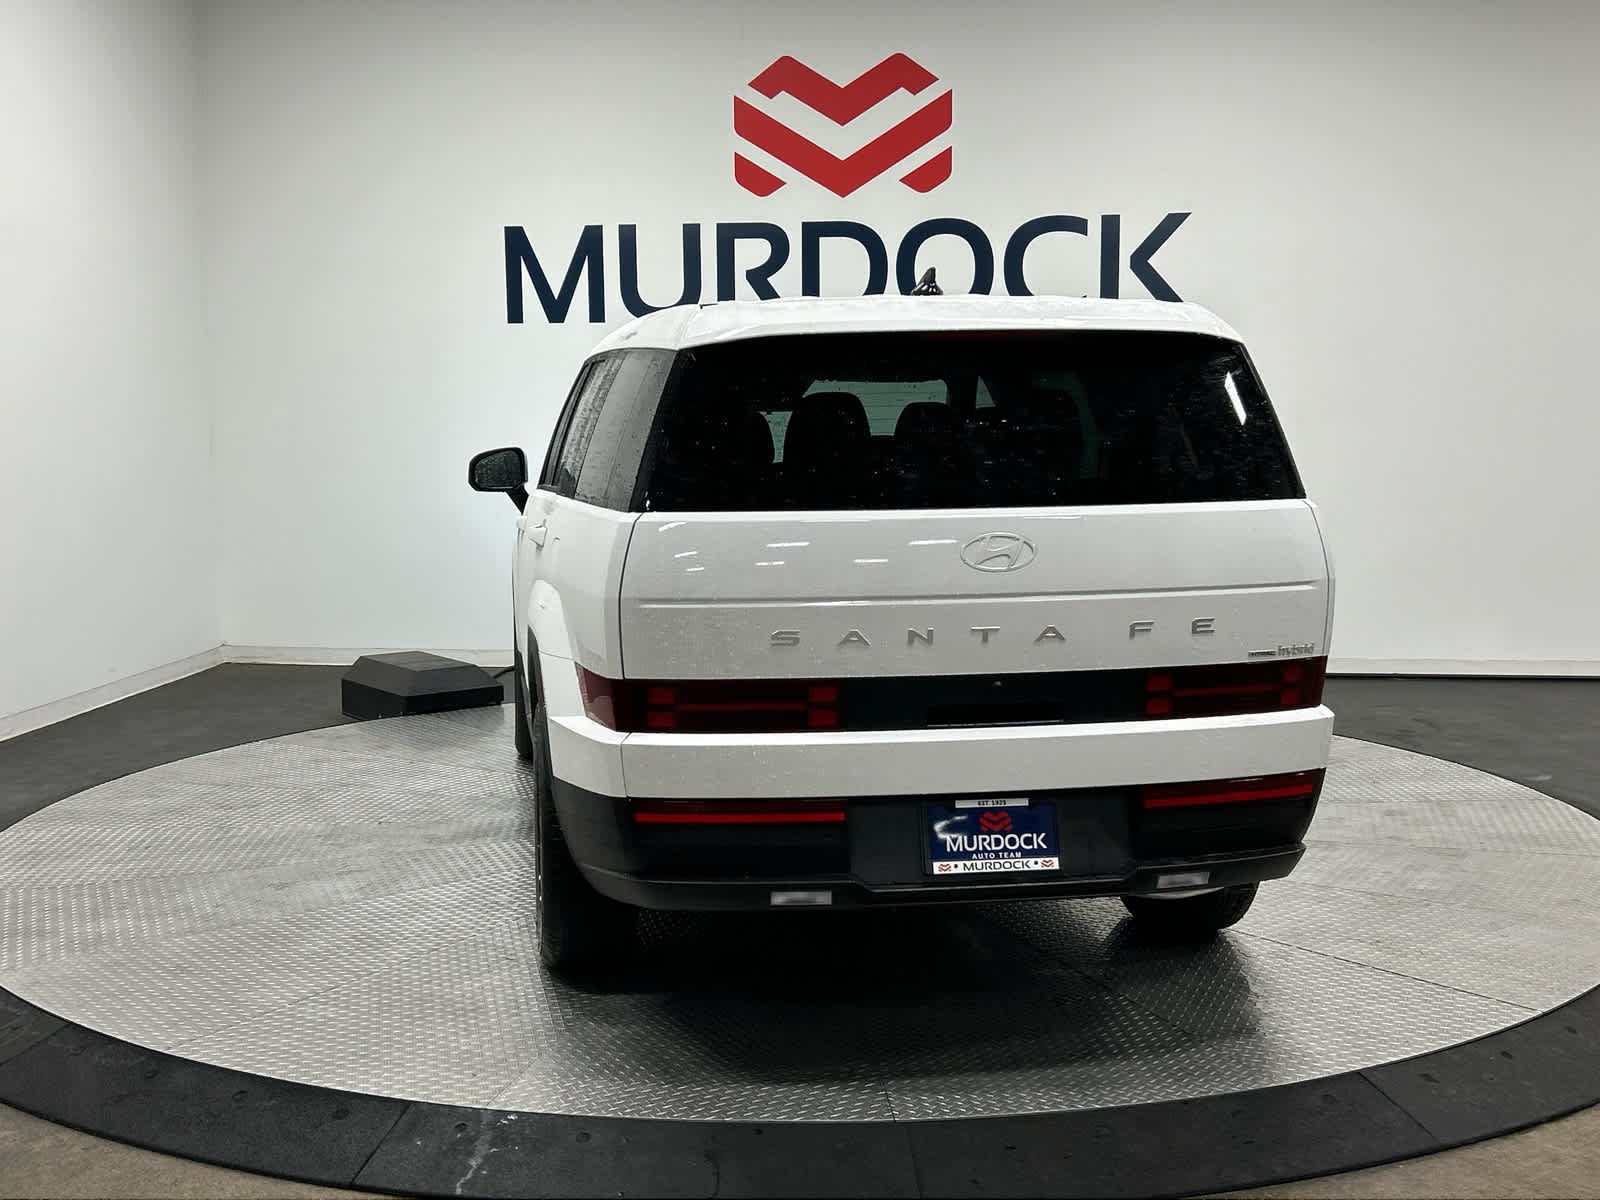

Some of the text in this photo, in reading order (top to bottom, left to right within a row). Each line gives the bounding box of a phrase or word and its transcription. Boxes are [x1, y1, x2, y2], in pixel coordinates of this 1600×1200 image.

[504, 212, 1192, 324] MURDOCK
[770, 617, 1215, 648] SANTA FE
[946, 833, 1047, 852] MURDOCK
[963, 860, 1031, 871] MURDOCK
